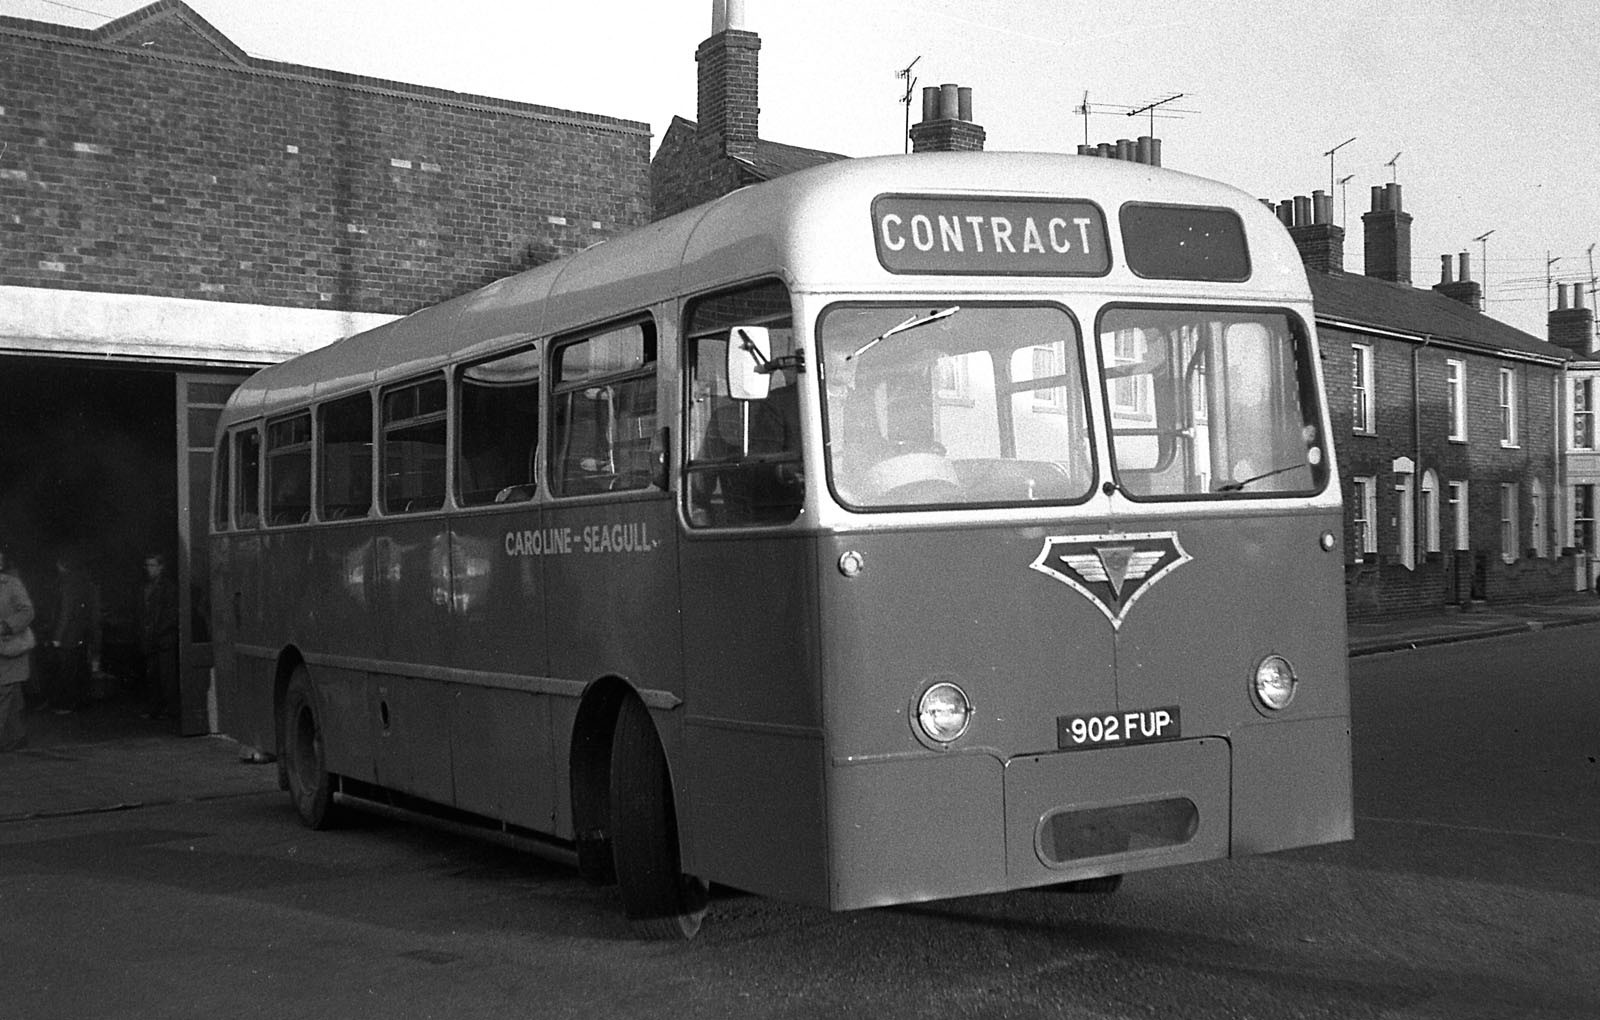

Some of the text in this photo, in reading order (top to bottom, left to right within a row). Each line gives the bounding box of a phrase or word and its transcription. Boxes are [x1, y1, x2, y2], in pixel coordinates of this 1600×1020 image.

[881, 213, 1091, 254] CONTRACT
[1071, 710, 1171, 743] 902 FUP
